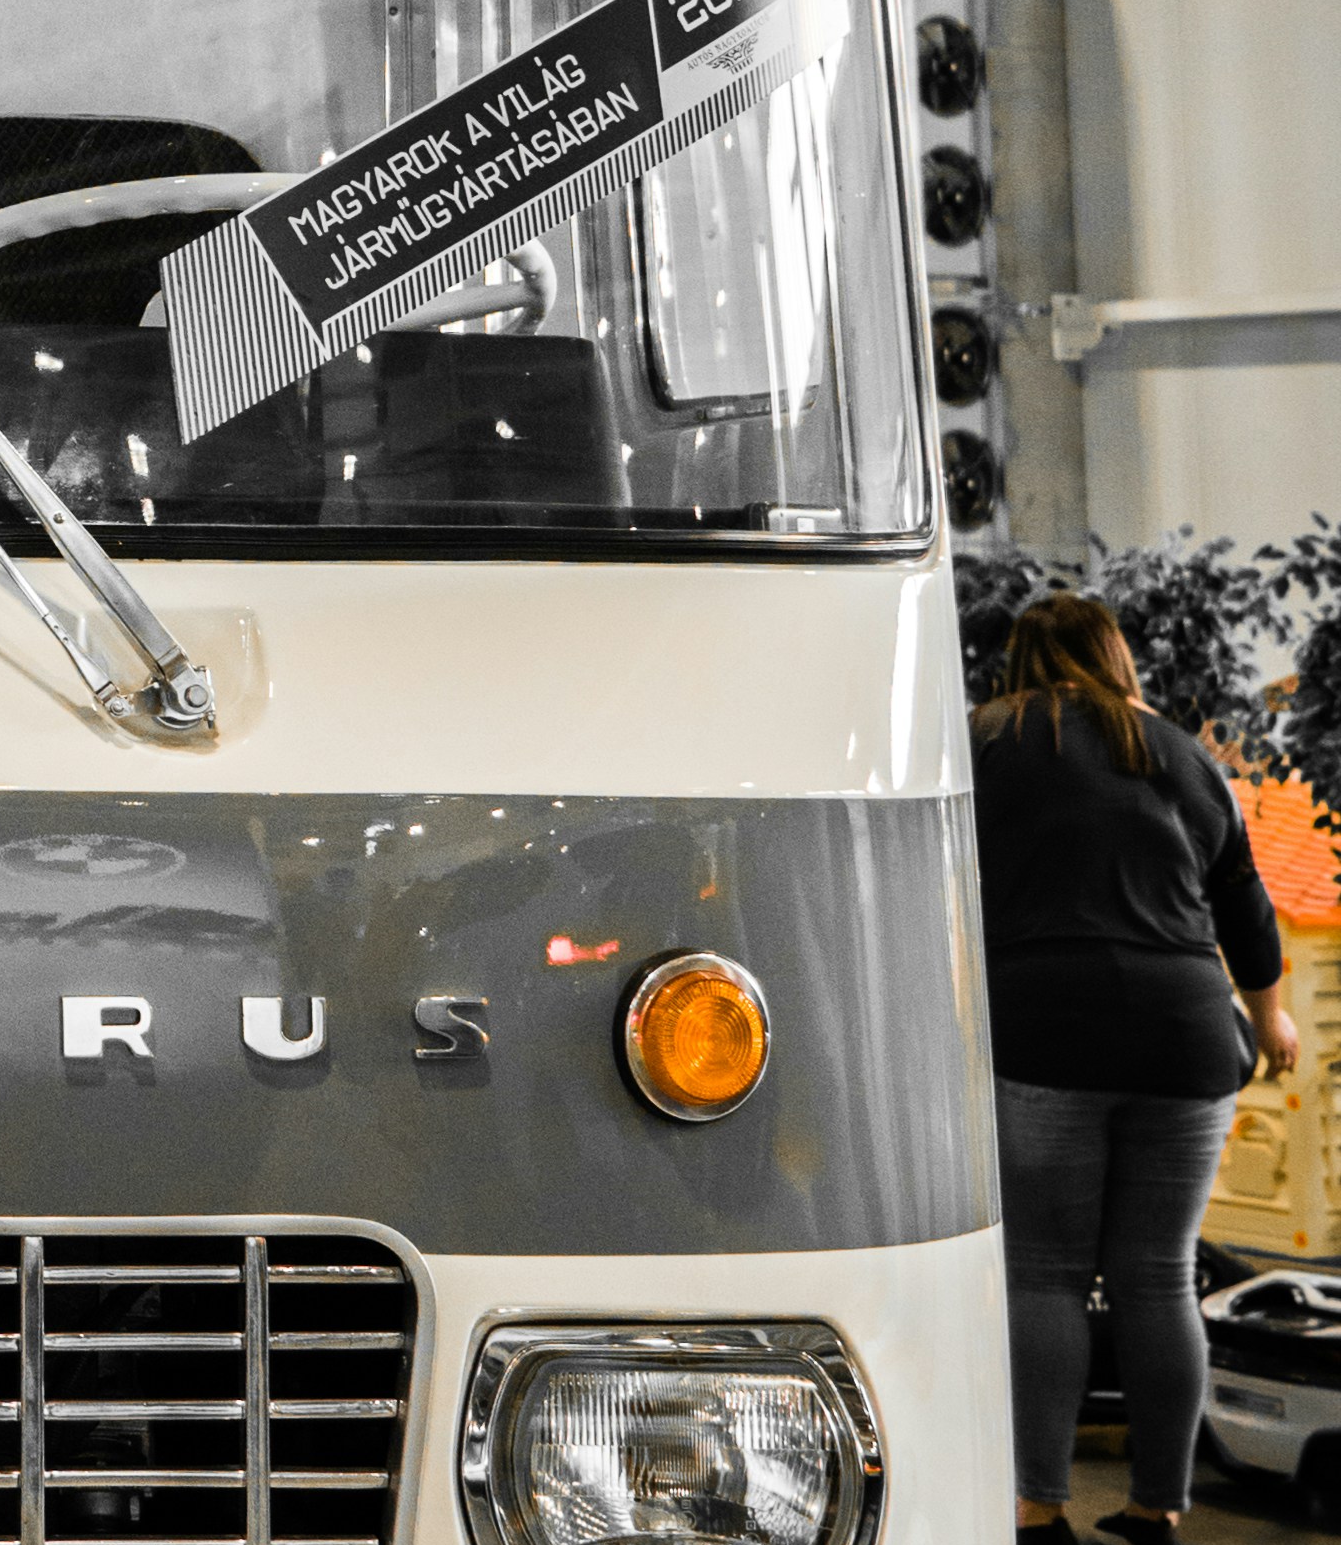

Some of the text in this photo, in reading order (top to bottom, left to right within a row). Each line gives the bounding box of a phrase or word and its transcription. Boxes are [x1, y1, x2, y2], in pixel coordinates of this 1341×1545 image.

[287, 55, 587, 246] MAGYAROK A VILÁG
[324, 82, 640, 291] JÁRMŰGYÁRTÁSÁBAN
